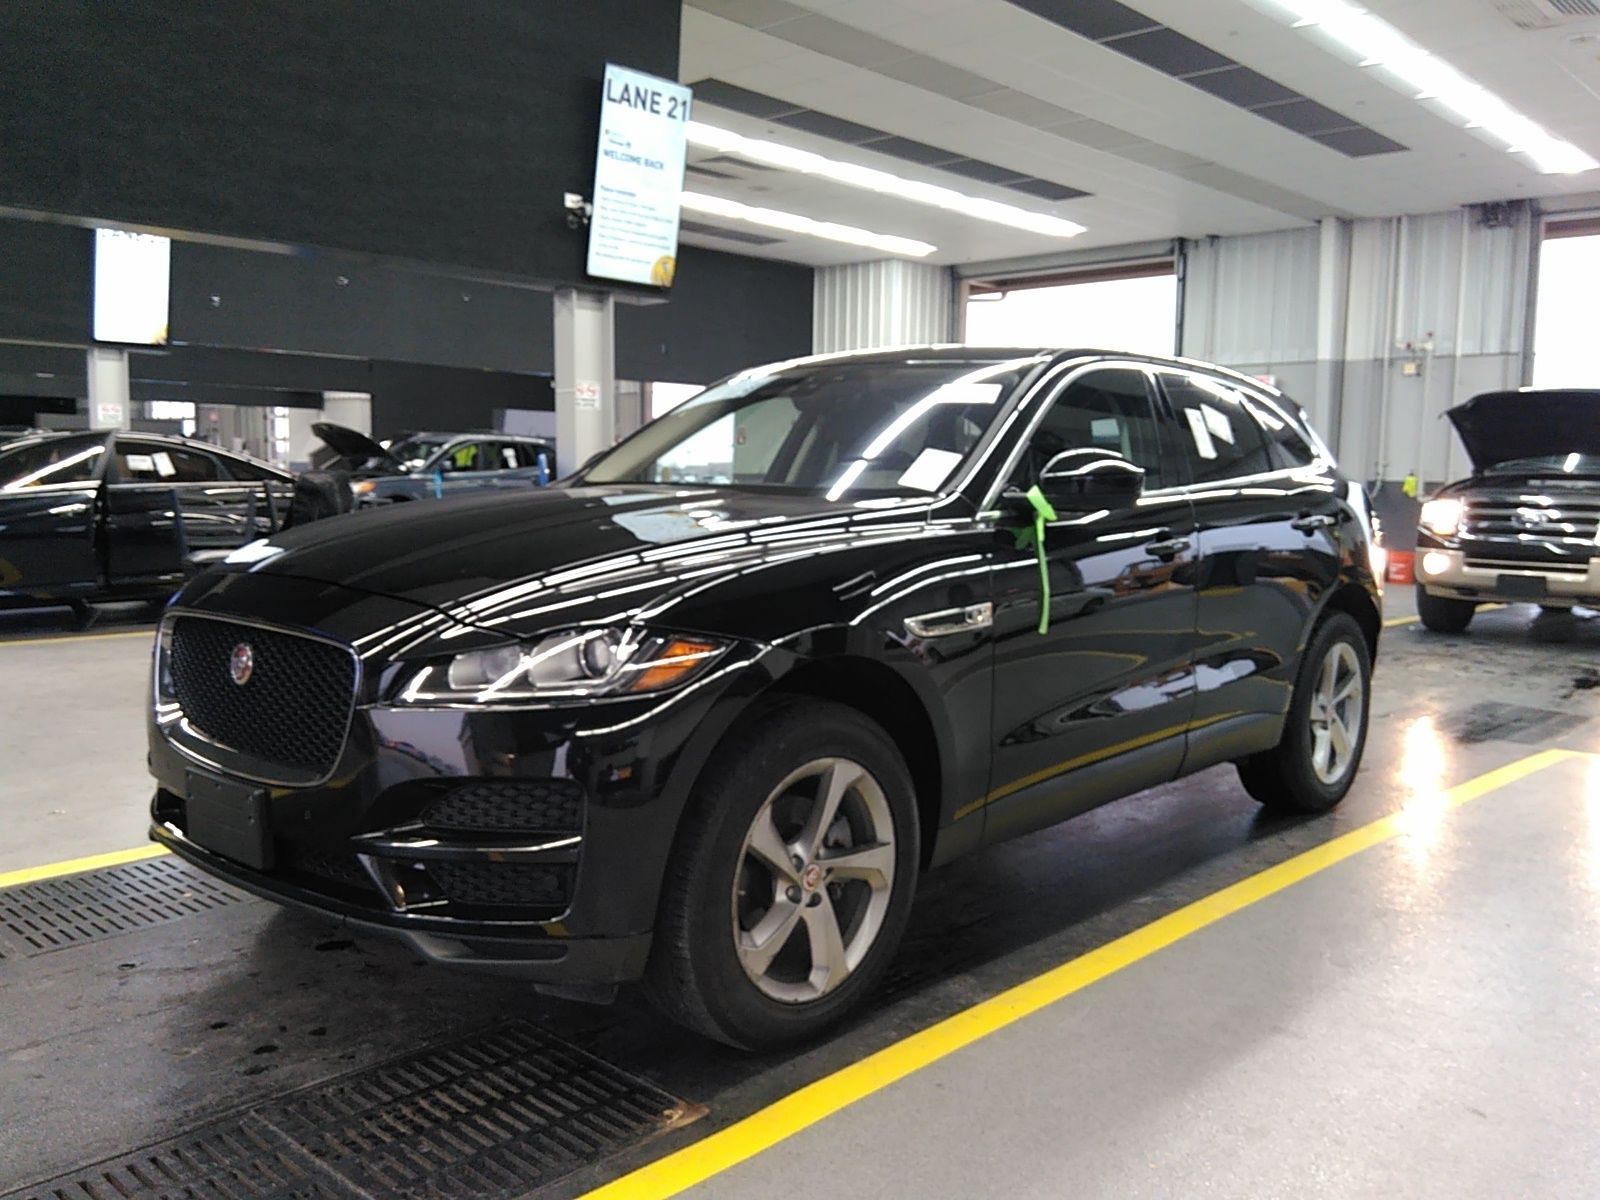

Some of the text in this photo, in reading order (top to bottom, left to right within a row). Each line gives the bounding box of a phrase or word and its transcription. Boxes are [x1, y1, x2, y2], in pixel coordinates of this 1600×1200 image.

[606, 78, 688, 122] LANE 21
[603, 148, 664, 170] WELCOME BACK
